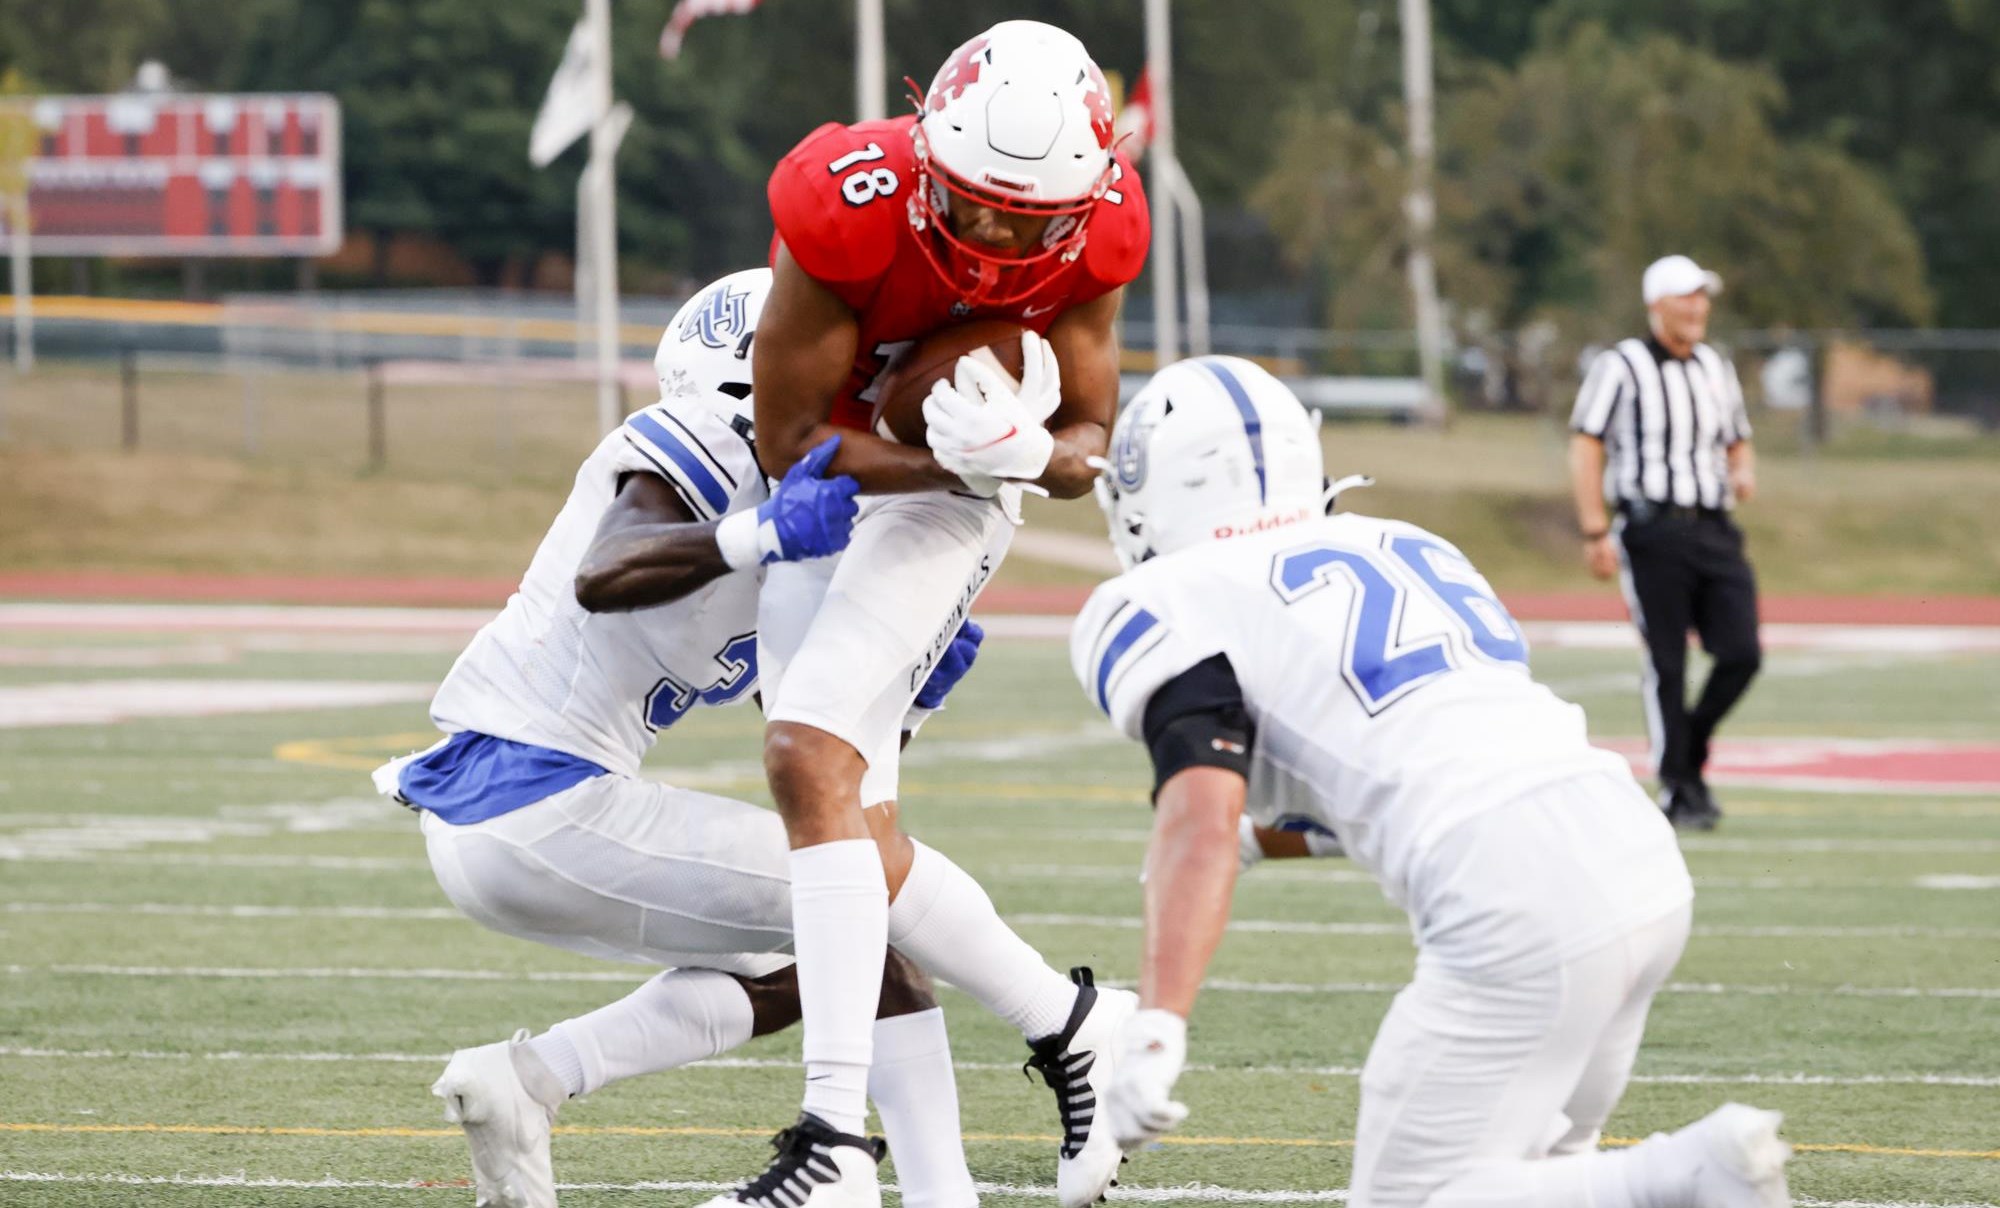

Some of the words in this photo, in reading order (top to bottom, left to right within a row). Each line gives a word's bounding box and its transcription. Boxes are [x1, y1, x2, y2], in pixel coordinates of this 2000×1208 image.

[827, 141, 900, 208] 18
[643, 630, 758, 734] 3
[910, 553, 990, 693] CARDINALS
[1269, 530, 1531, 718] 26
